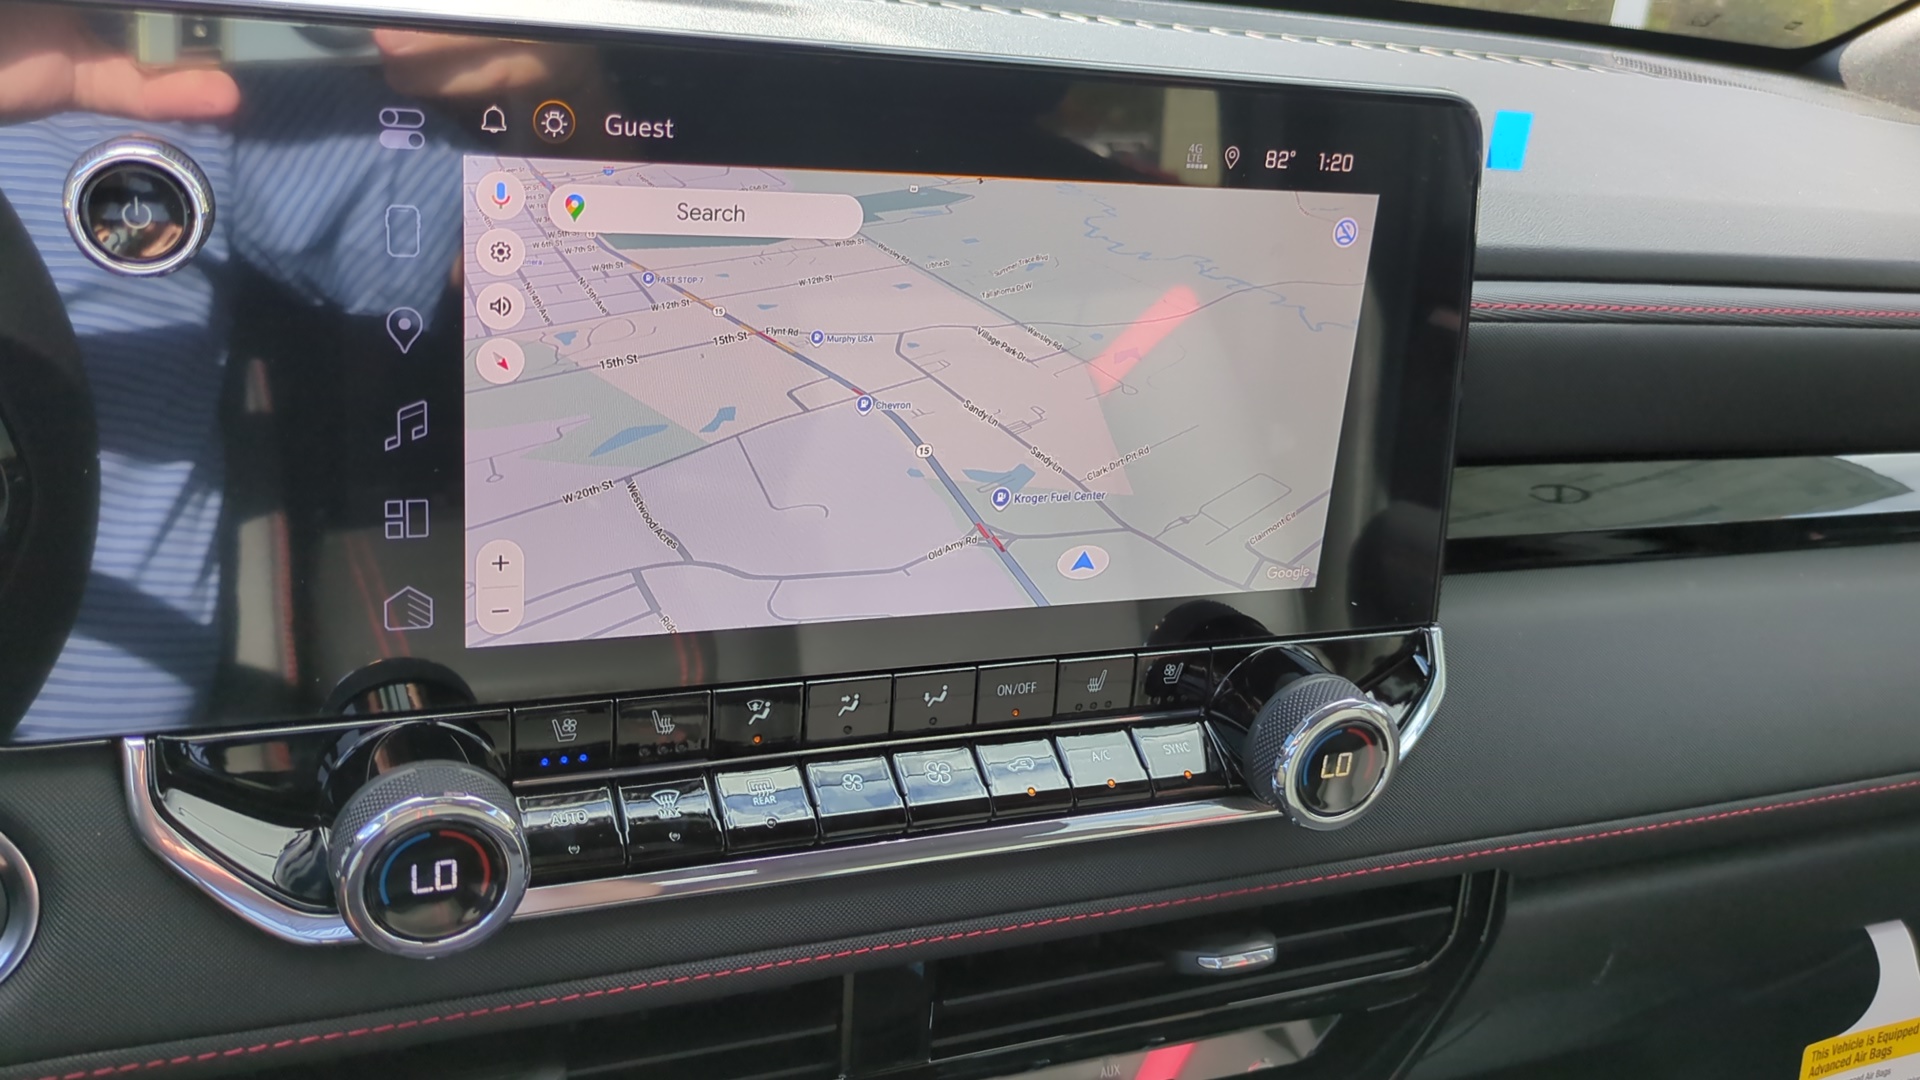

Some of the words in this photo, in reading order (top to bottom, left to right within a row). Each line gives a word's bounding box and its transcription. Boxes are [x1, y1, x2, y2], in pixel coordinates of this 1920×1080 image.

[604, 113, 675, 140] Guest
[1188, 143, 1203, 154] 4G
[1186, 153, 1203, 163] LTE
[1264, 150, 1297, 169] 82°
[1318, 152, 1354, 173] 1:20
[676, 201, 746, 223] Search
[877, 242, 901, 260] Wansley
[900, 254, 910, 264] Rd
[600, 264, 614, 272] 9th
[678, 276, 698, 284] STOP
[798, 279, 808, 287] W
[808, 276, 824, 286] 12th
[824, 274, 834, 282] St
[1024, 282, 1033, 290] W
[578, 276, 586, 286] N
[583, 284, 598, 302] 15th
[594, 298, 608, 314] Ave
[528, 290, 543, 310] 14th
[540, 307, 551, 324] Ave
[650, 304, 660, 312] W
[662, 300, 680, 310] 12th
[680, 299, 691, 308] St
[712, 333, 735, 346] 15th
[736, 331, 748, 342] St
[766, 326, 786, 338] Flynt
[787, 328, 800, 337] Rd
[826, 335, 857, 346] Murphy
[858, 334, 874, 344] USA
[1026, 326, 1053, 347] Wansley
[1052, 340, 1063, 351] Rd
[976, 327, 1001, 348] Village
[1000, 341, 1017, 356] Park
[1016, 350, 1027, 362] Dr
[600, 356, 624, 370] 15th
[626, 354, 638, 364] St
[876, 402, 912, 410] Chevron
[962, 399, 989, 422] Sandy
[988, 416, 999, 427] Ln
[919, 447, 930, 455] 15
[1030, 446, 1054, 469] Sandy
[1052, 462, 1064, 474] Ln
[1086, 466, 1108, 481] Clark
[1108, 458, 1126, 471] Dirt
[1126, 452, 1138, 464] Pit
[1137, 446, 1150, 458] Rd
[562, 492, 574, 504] W
[576, 485, 600, 500] 20th
[602, 479, 615, 491] St
[1014, 492, 1048, 504] Kroger
[1050, 492, 1072, 502] Fuel
[1074, 491, 1106, 501] Center
[626, 481, 659, 530] Westwood
[654, 528, 678, 550] Acres
[1249, 518, 1286, 546] Clairmont
[1286, 510, 1298, 522] Cir
[928, 547, 944, 560] Old
[965, 536, 978, 546] Rd
[1266, 565, 1310, 580] Google
[996, 682, 1038, 696] ON/OFF
[1092, 750, 1112, 762] A/C
[1162, 742, 1192, 756] SYNC
[1320, 752, 1352, 780] LO
[752, 794, 776, 806] REAR
[551, 809, 589, 826] AUTO
[658, 808, 682, 818] MAX
[410, 858, 458, 896] LO
[1812, 1048, 1830, 1062] This
[1832, 1038, 1865, 1056] Vehicle
[1866, 1034, 1875, 1047] is
[1878, 1022, 1920, 1044] Equipped
[1808, 1054, 1853, 1079] Advanced
[1853, 1051, 1868, 1065] Air
[1870, 1046, 1893, 1060] Bags
[1100, 1064, 1121, 1079] AUX
